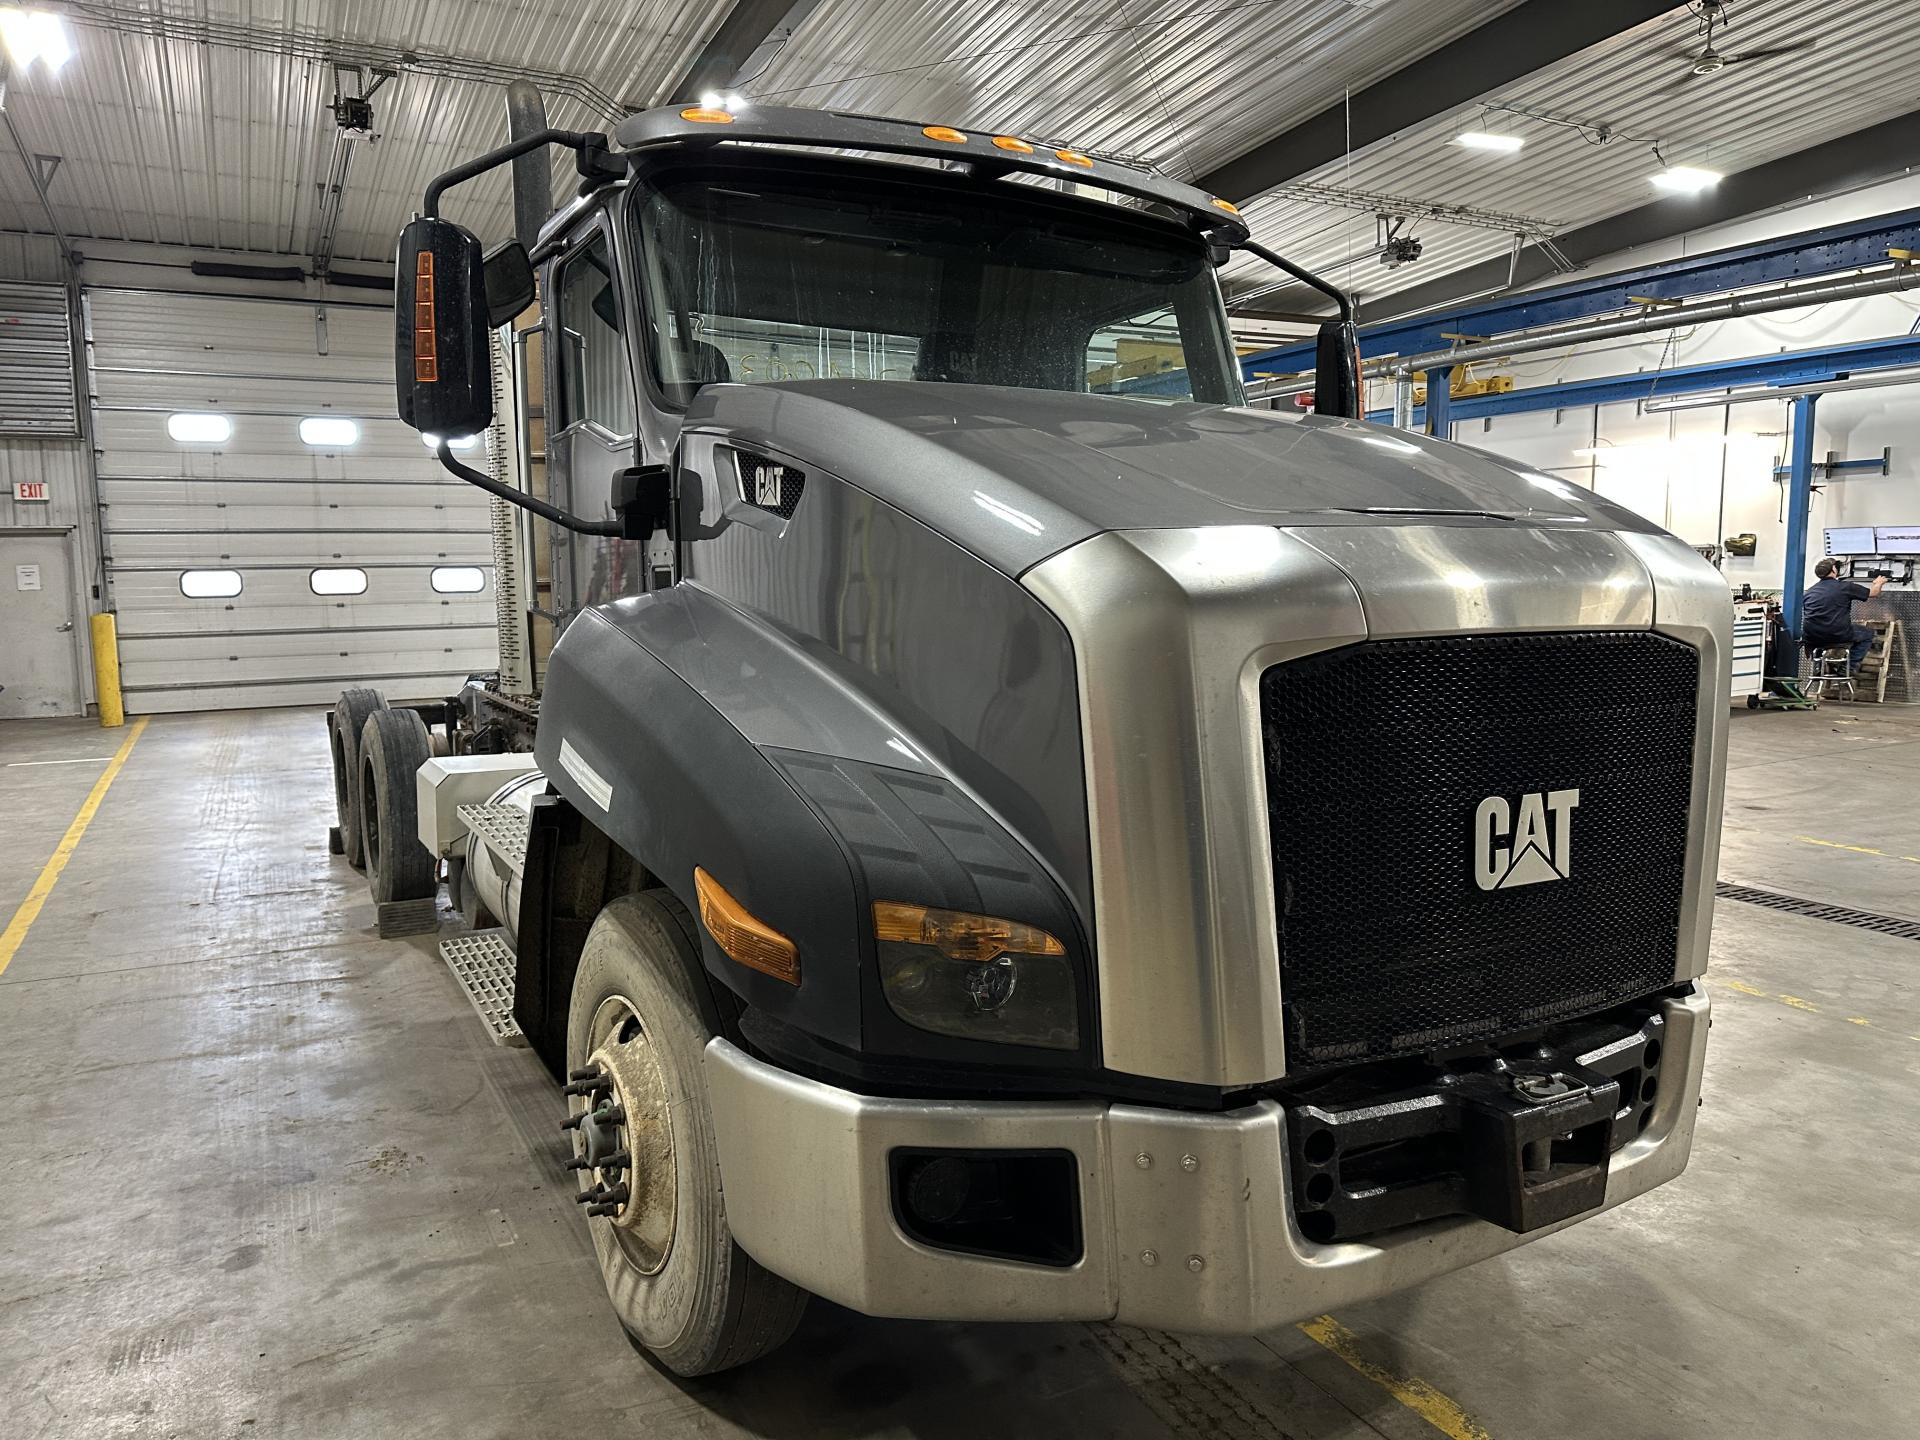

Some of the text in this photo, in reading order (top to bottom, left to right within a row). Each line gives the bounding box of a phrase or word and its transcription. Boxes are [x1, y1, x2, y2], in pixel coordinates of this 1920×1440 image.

[20, 483, 43, 498] EXIT
[756, 466, 784, 506] CAT
[1475, 788, 1580, 891] CAT
